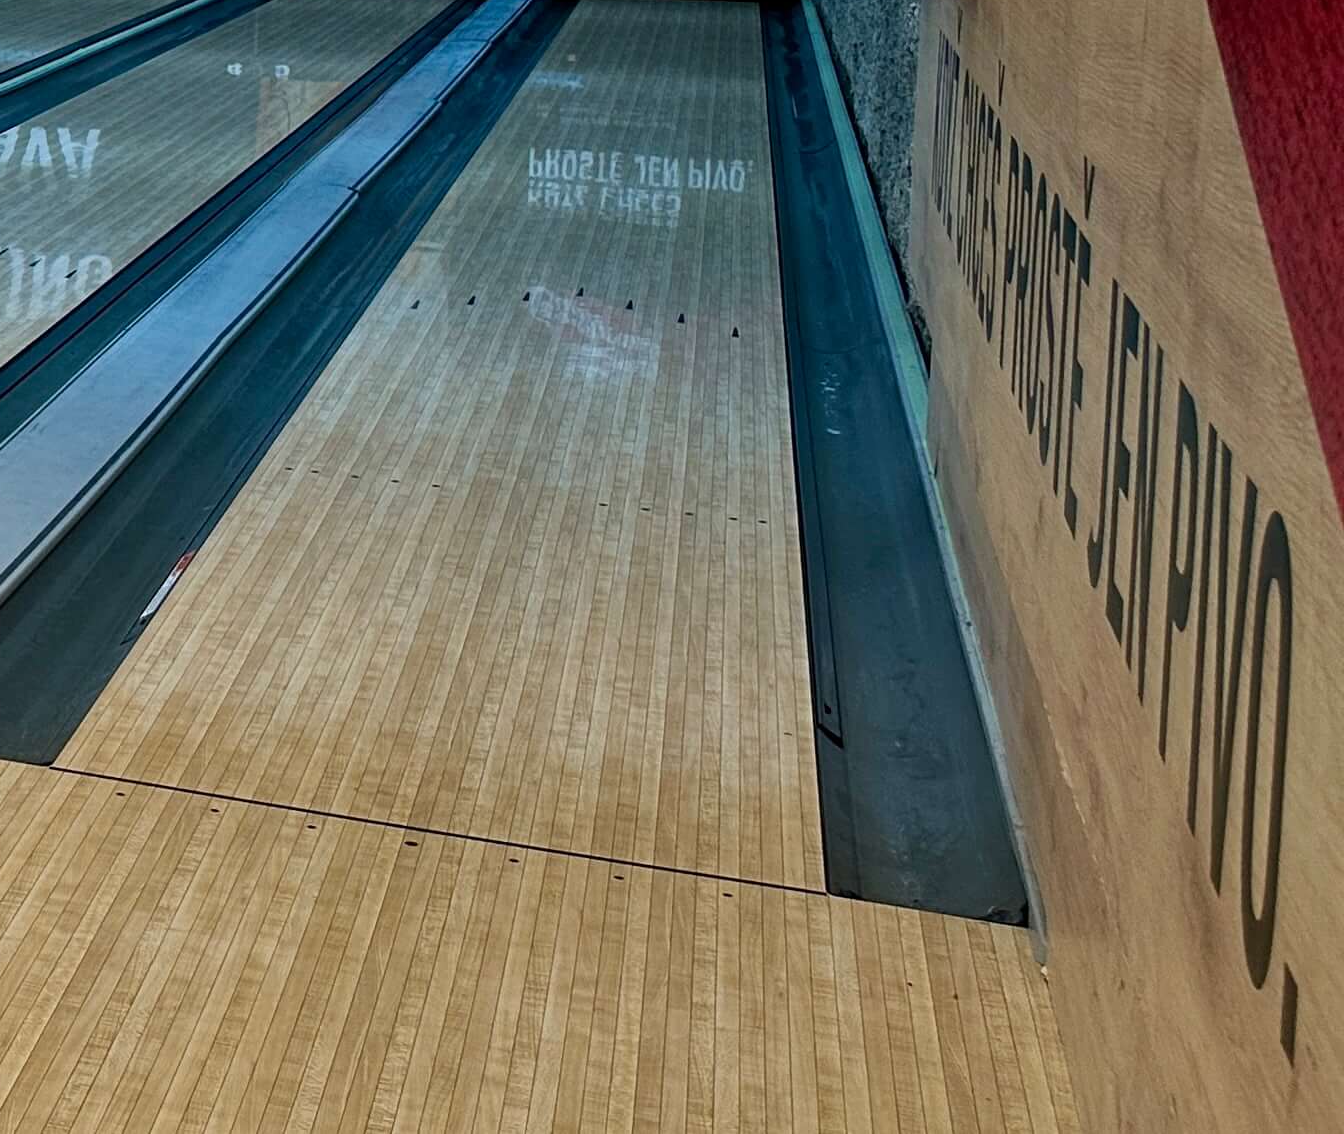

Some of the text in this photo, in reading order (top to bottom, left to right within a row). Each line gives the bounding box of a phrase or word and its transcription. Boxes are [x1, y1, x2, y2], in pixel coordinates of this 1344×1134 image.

[956, 59, 1005, 342] CHCEŠ
[999, 135, 1095, 540] PROSTĚ
[1087, 275, 1164, 707] JEN
[1159, 377, 1298, 1071] PIVO.
